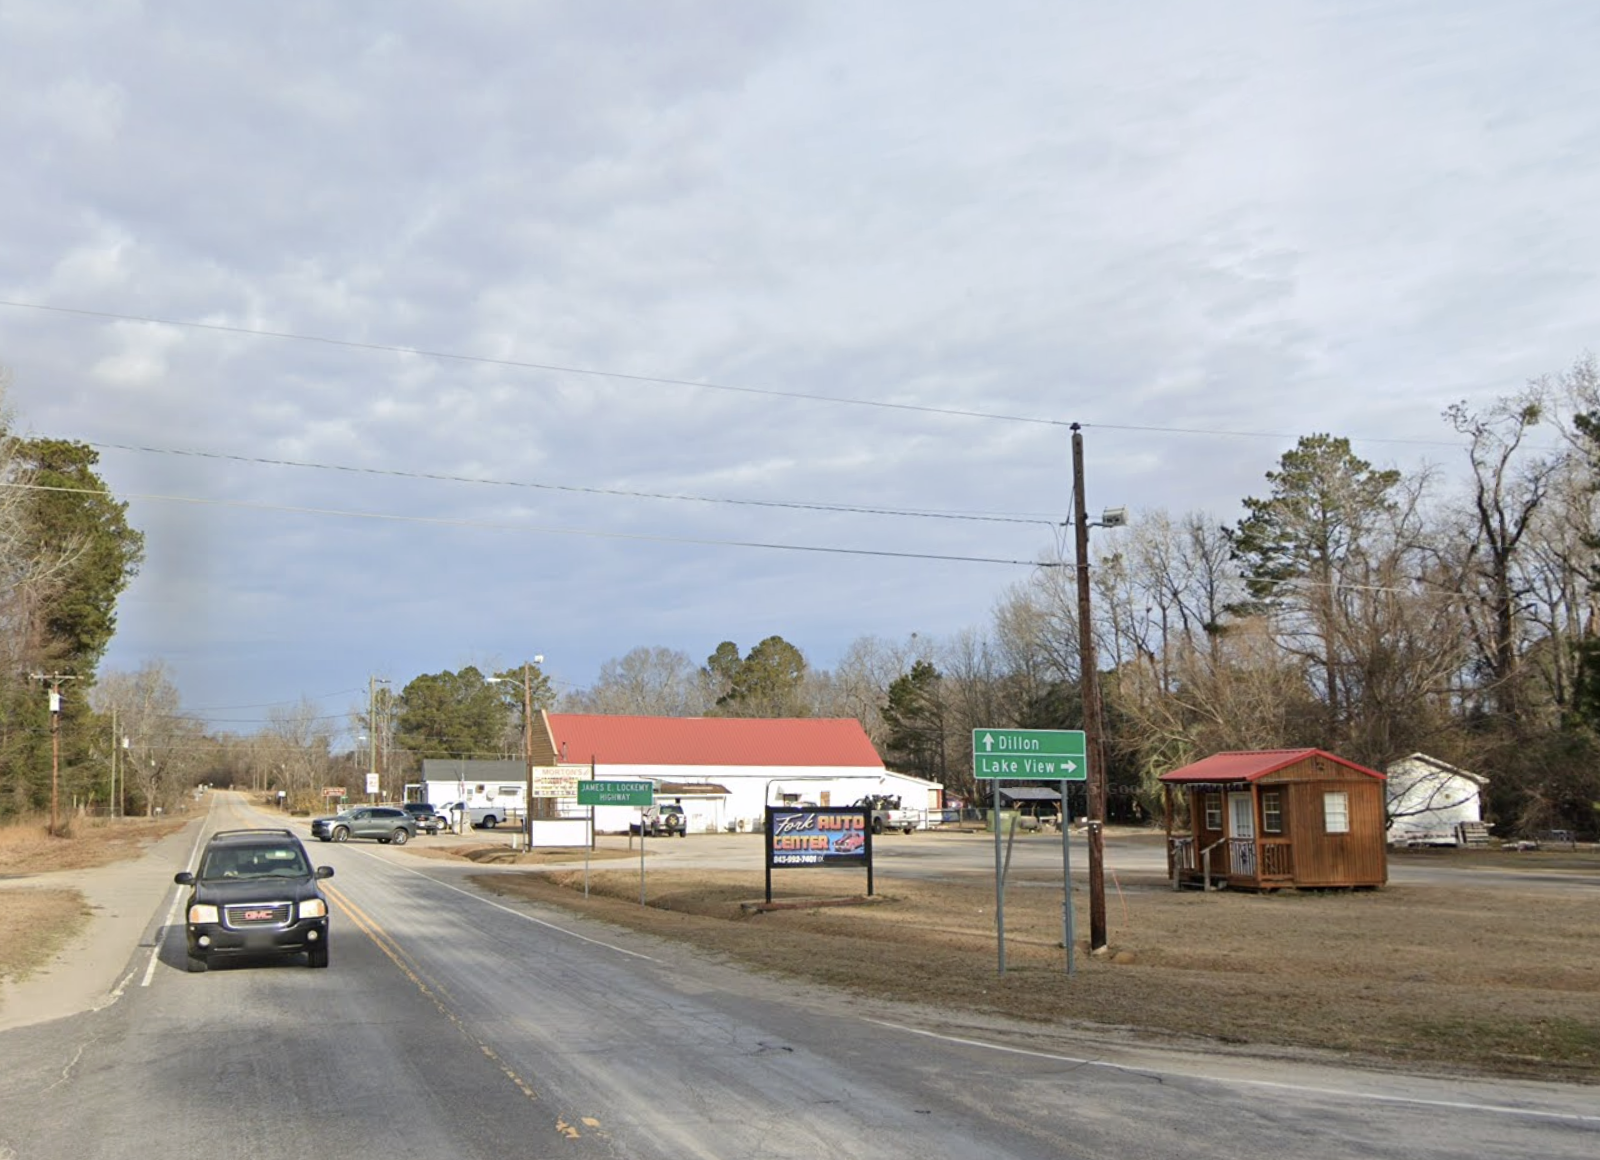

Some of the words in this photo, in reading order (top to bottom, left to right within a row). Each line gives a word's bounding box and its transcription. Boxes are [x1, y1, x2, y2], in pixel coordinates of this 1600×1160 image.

[999, 736, 1039, 750] Dillon
[982, 759, 1018, 772] Lake
[1024, 759, 1055, 773] View
[581, 783, 605, 792] JAMES
[607, 783, 614, 792] E.
[616, 783, 650, 792] LOCKEMY
[599, 793, 631, 801] HIGHWAY
[775, 813, 816, 836] Fork
[817, 815, 865, 830] AUTO
[773, 835, 829, 850] CENTER
[244, 910, 273, 920] GMC
